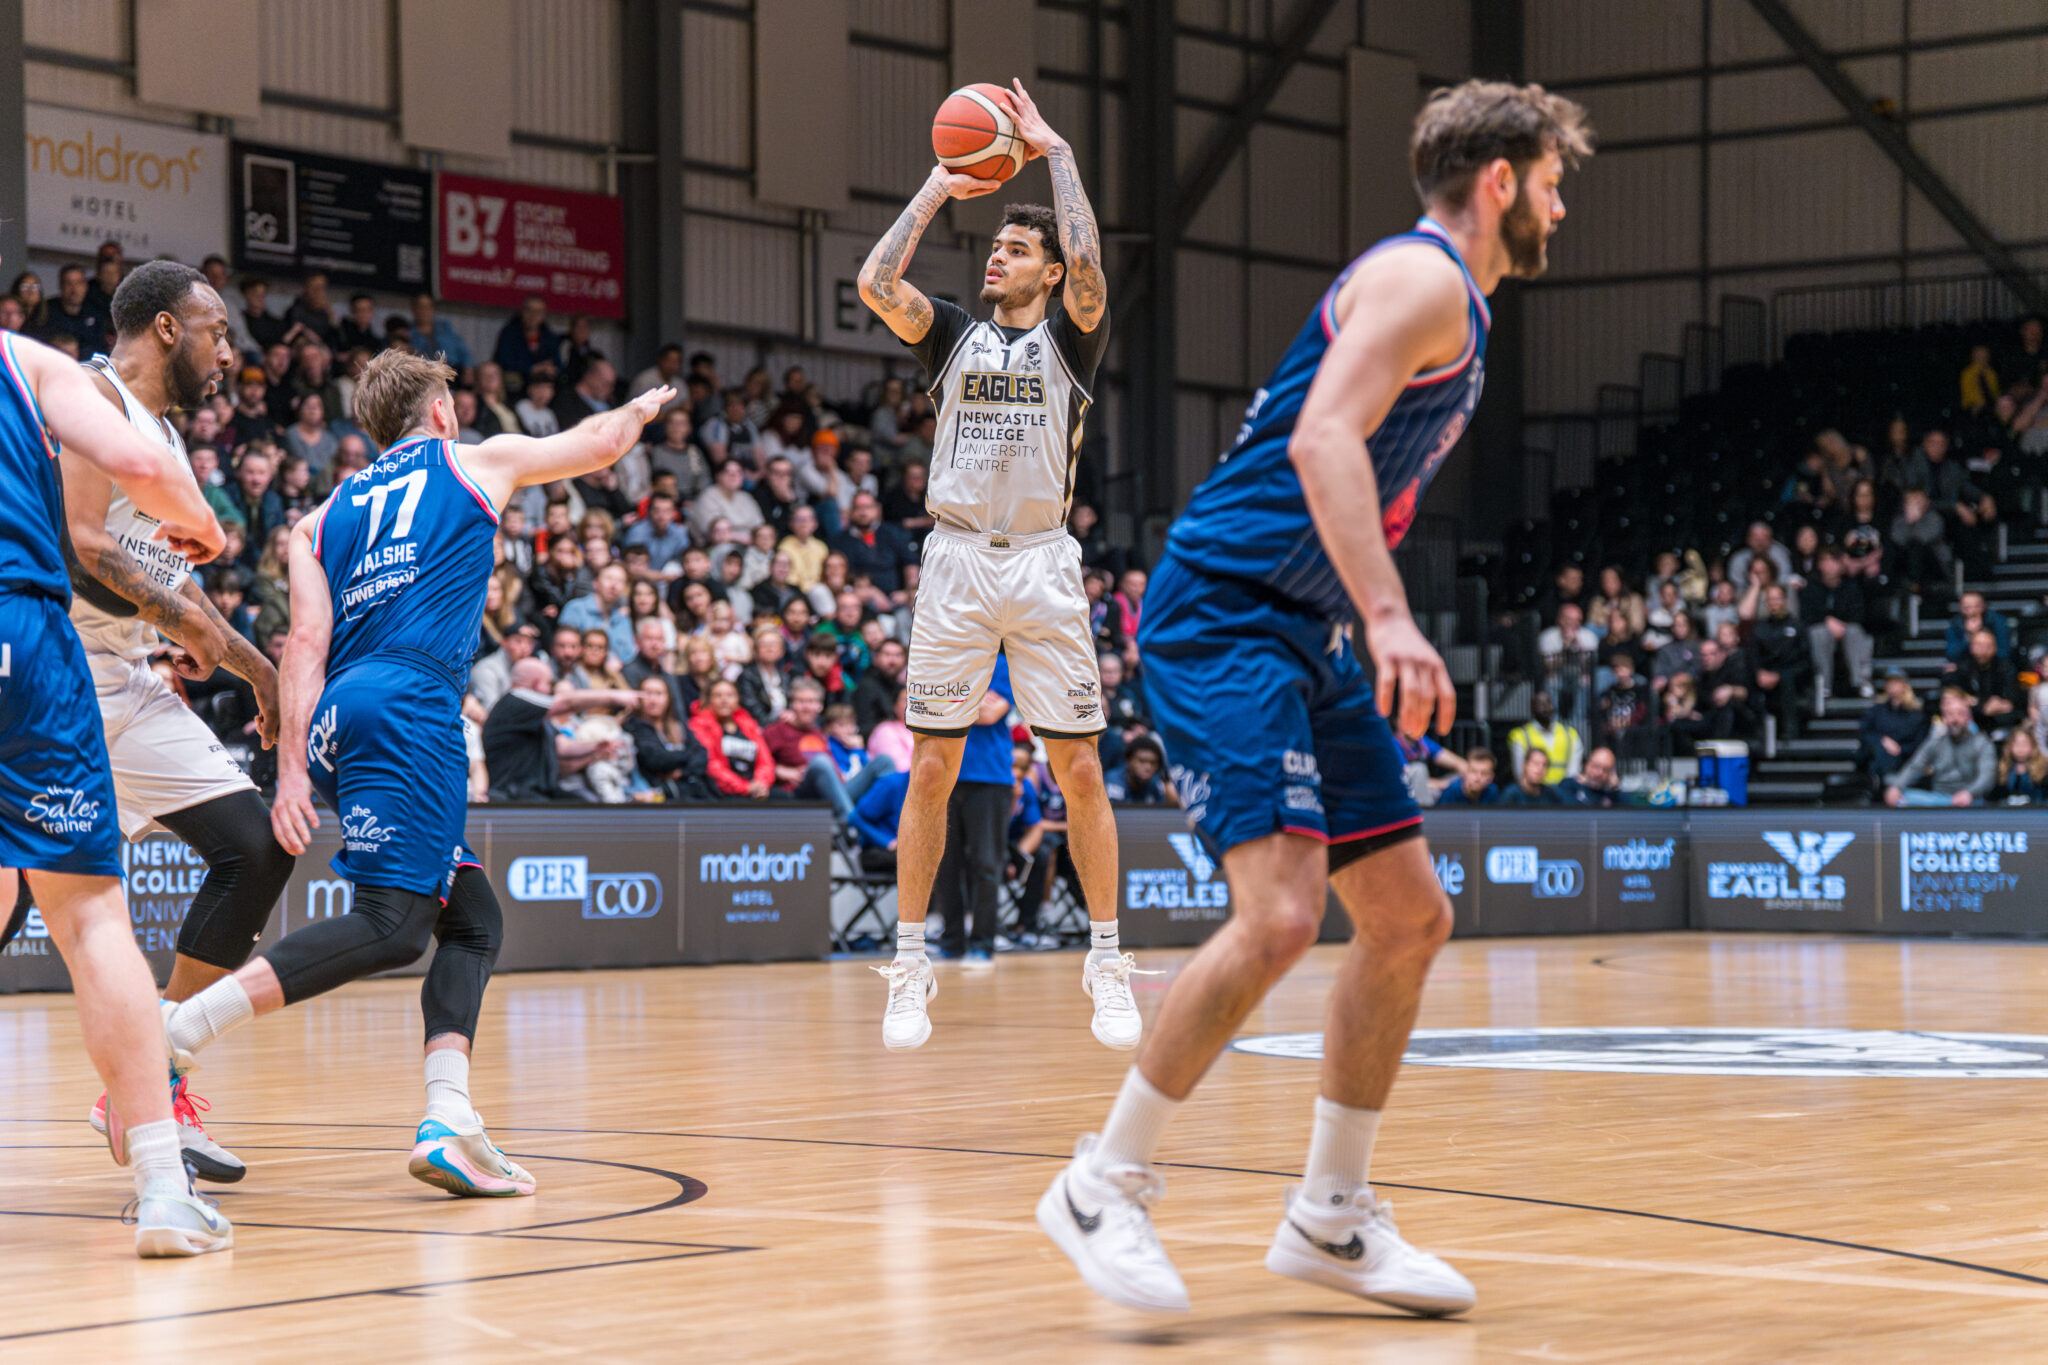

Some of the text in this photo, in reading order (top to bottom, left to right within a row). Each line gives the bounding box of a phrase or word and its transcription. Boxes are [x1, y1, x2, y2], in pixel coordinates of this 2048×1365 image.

[71, 196, 137, 223] HOTEL
[962, 373, 1045, 405] EAGLES
[963, 411, 1047, 426] NEWCASTLE
[961, 427, 1025, 441] COLLEGE
[958, 444, 1039, 458] UNIVERSITY
[956, 458, 1010, 473] CENTRE
[352, 469, 428, 551] 77
[126, 537, 191, 574] NEWCASTL
[345, 584, 376, 607] UWE
[909, 682, 971, 697] muckle
[25, 790, 99, 823] Sales
[352, 804, 371, 819] the
[42, 819, 93, 834] trainer
[342, 815, 397, 842] Sales
[132, 841, 205, 867] NEWC
[1910, 832, 2029, 852] NEWCASTLE
[700, 844, 806, 882] maldron
[1910, 851, 2001, 873] COLLEGE
[131, 869, 211, 896] COLLE
[523, 864, 578, 894] PER
[1708, 875, 1846, 899] EAGLES
[596, 879, 648, 916] CO
[1126, 882, 1229, 909] EAGLES
